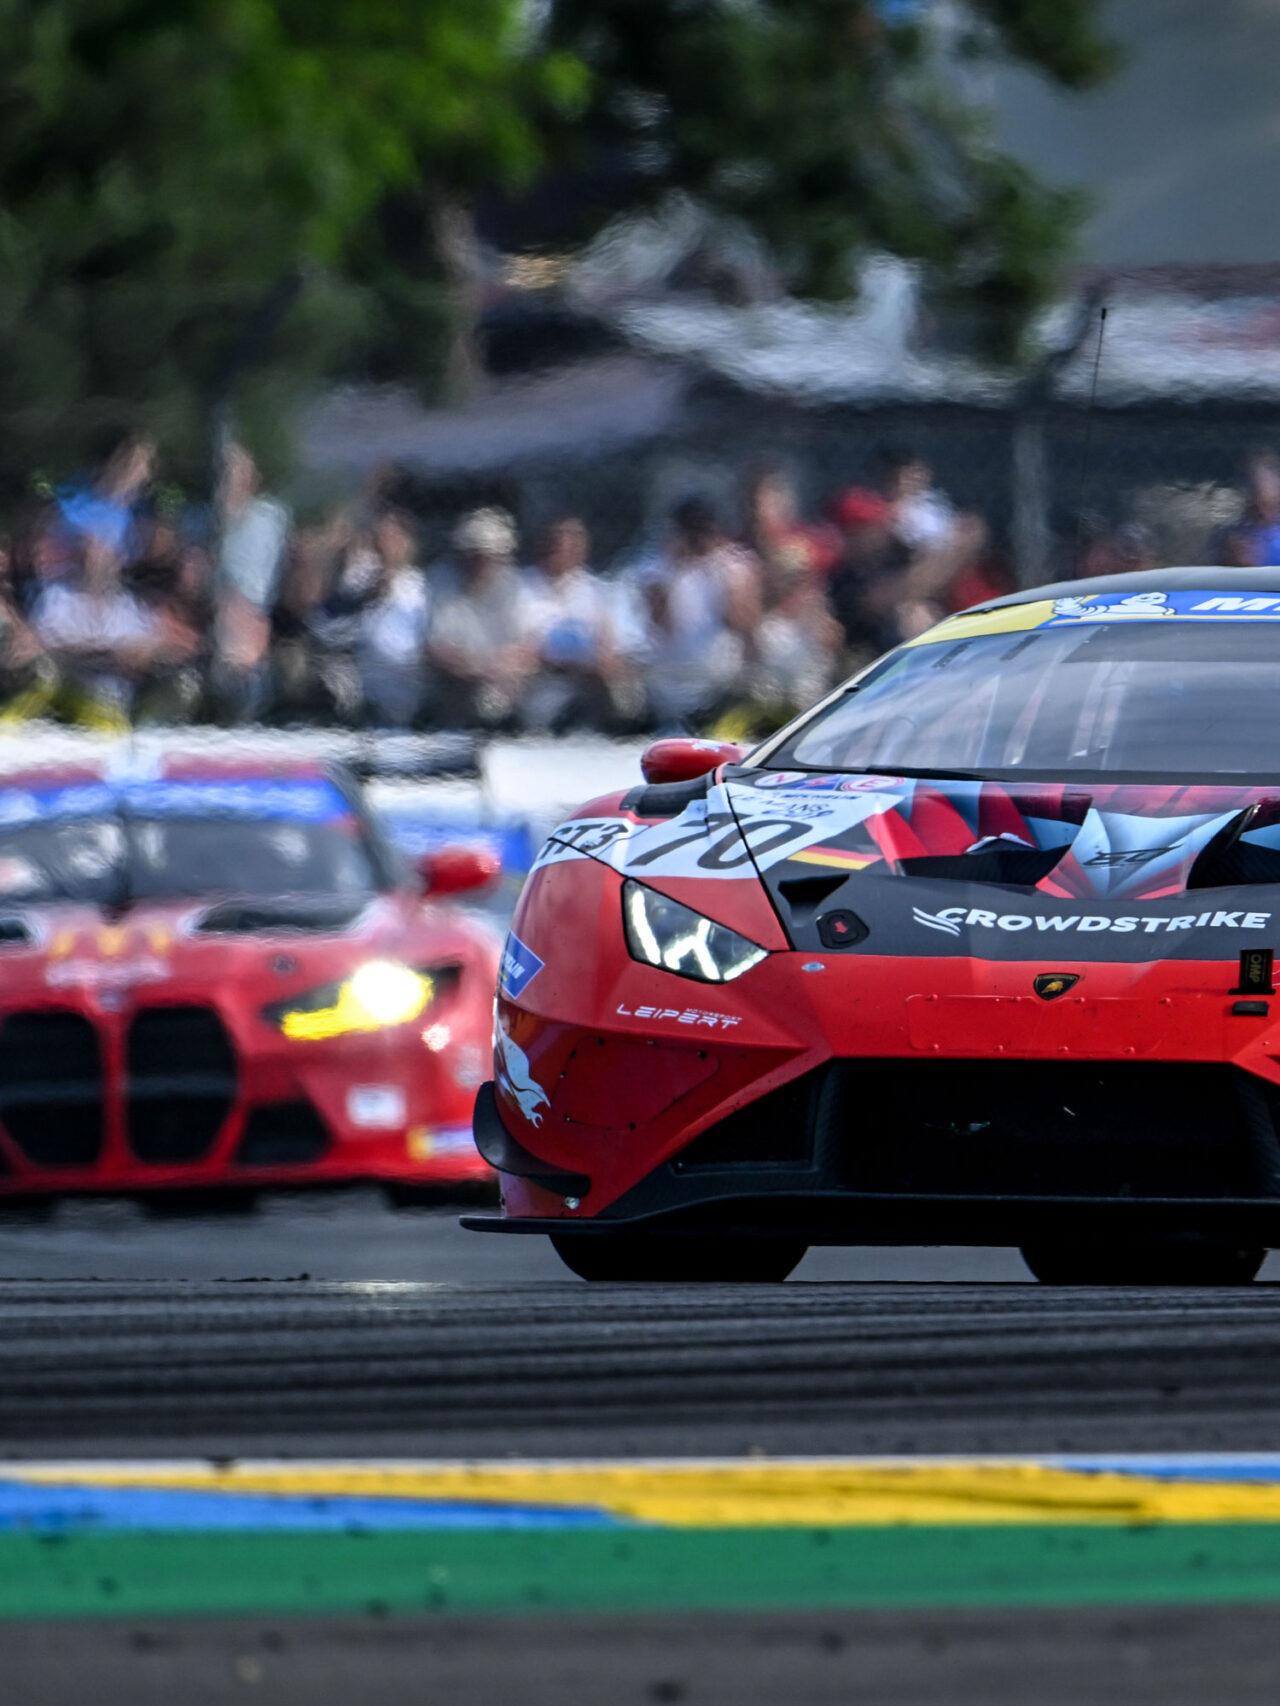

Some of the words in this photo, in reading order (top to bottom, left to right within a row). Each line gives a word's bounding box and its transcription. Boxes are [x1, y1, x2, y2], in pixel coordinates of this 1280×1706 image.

[540, 823, 630, 859] GT3
[626, 812, 813, 870] 70
[930, 907, 1272, 934] CROWDSTRIKE
[1249, 953, 1263, 984] OMP
[616, 1003, 739, 1029] LEIPERT
